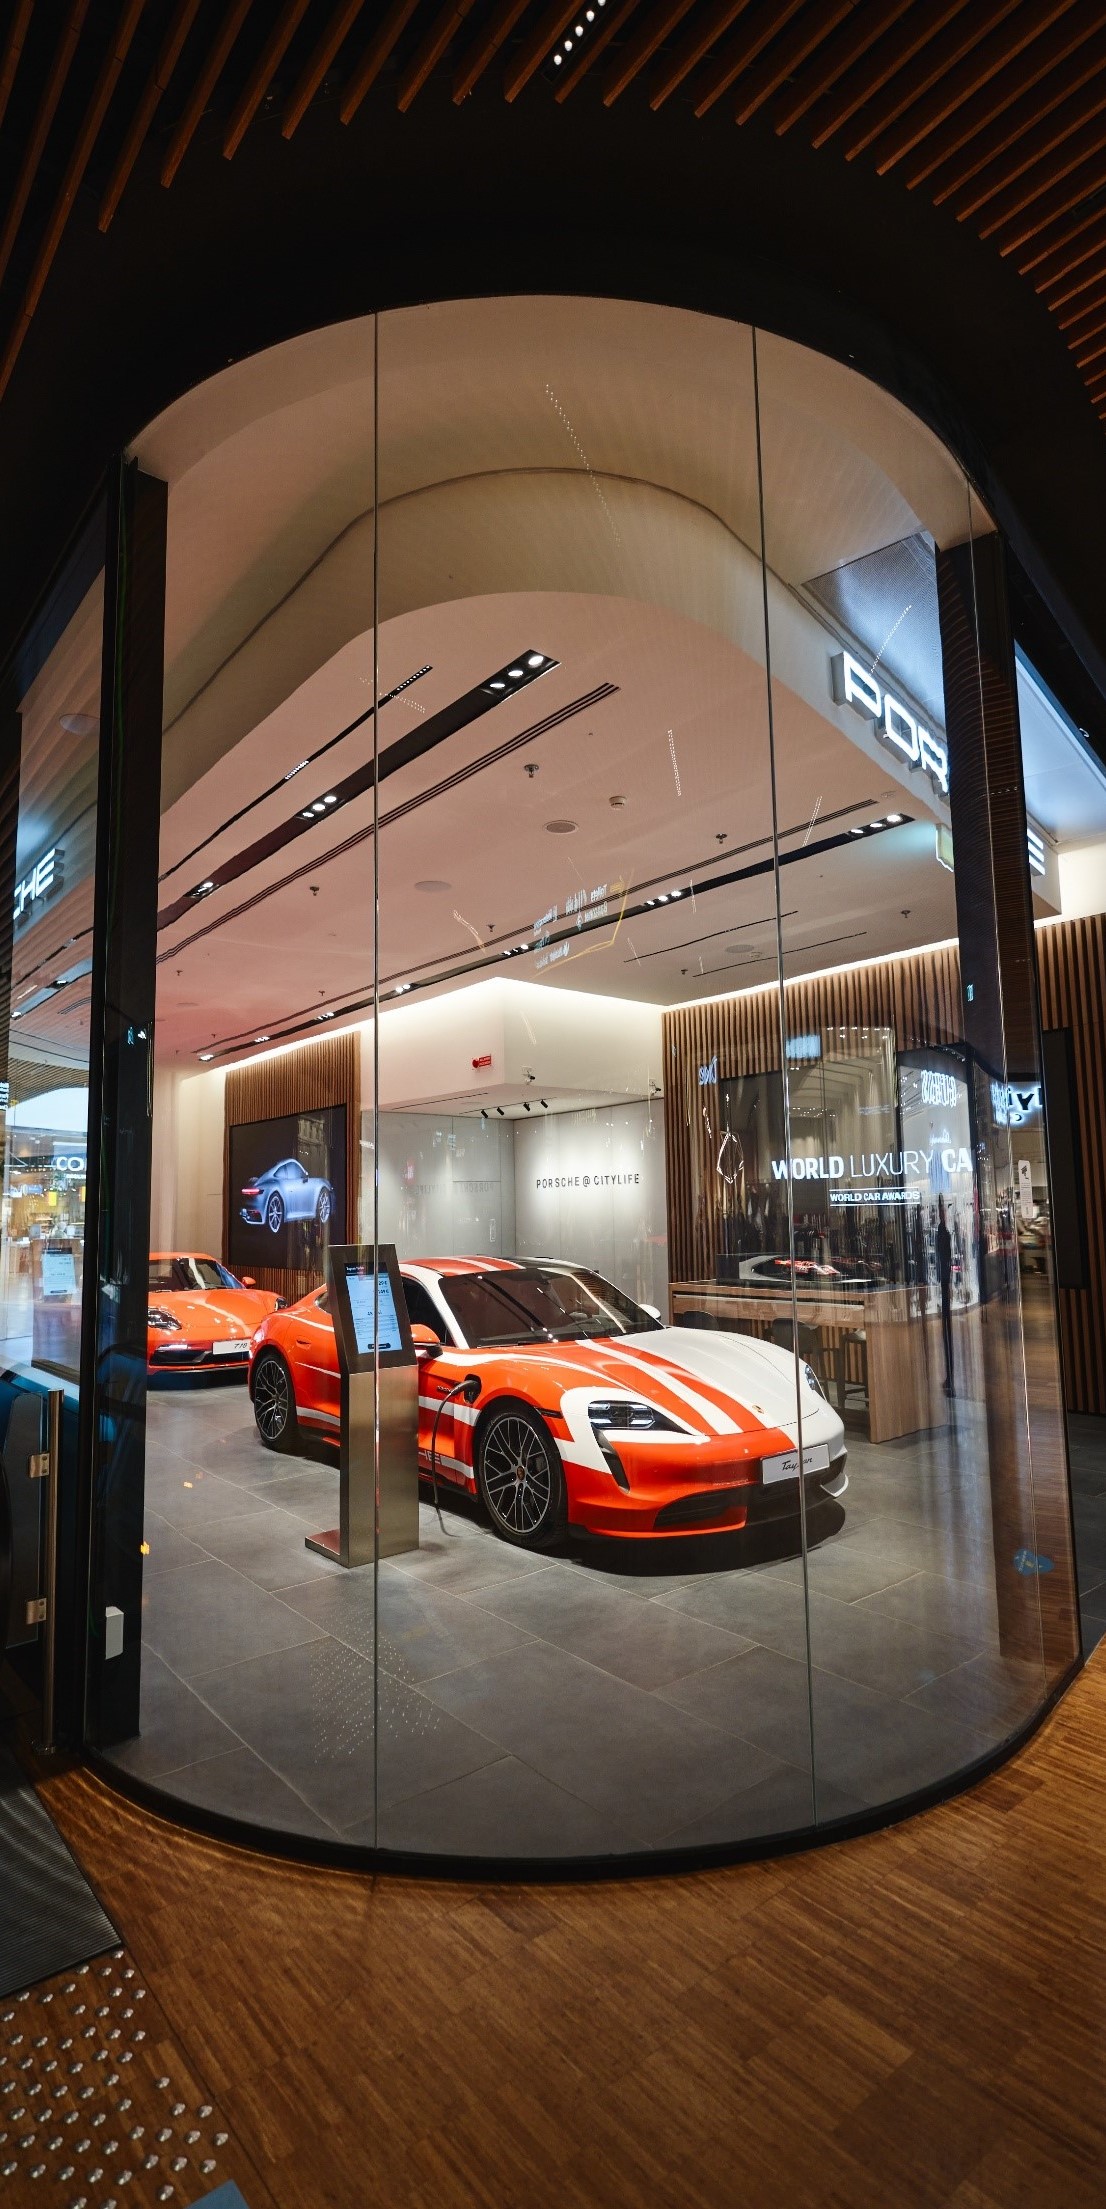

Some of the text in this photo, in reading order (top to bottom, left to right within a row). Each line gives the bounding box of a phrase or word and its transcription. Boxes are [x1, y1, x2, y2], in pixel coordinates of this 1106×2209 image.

[771, 1156, 844, 1180] WORLD
[850, 1150, 933, 1178] LUXURY
[536, 1173, 640, 1189] PORSCHE @ CITYLIFE
[829, 1191, 920, 1203] WORLD CAR AWARDS
[782, 1457, 812, 1471] Tayan
